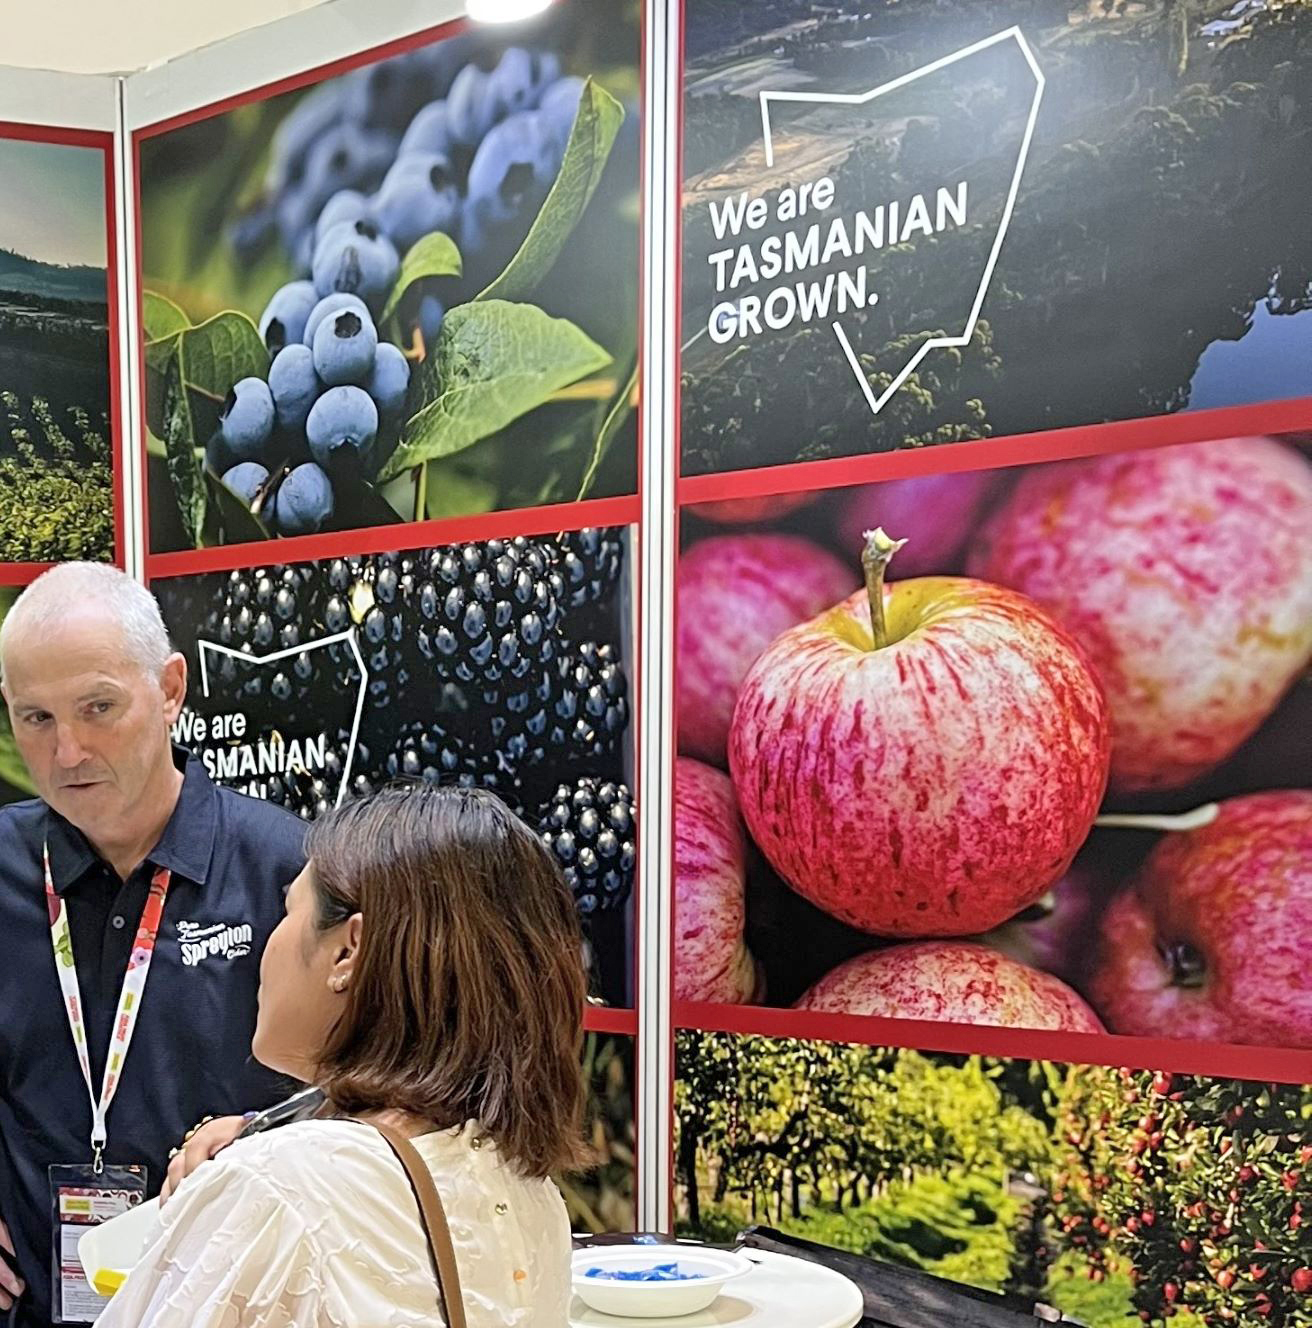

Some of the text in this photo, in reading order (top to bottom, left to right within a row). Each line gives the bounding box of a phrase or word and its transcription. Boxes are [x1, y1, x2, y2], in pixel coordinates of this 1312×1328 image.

[707, 180, 968, 292] TASMANIAN
[708, 176, 836, 240] We are
[707, 265, 879, 345] GROWN.
[171, 711, 246, 744] We are
